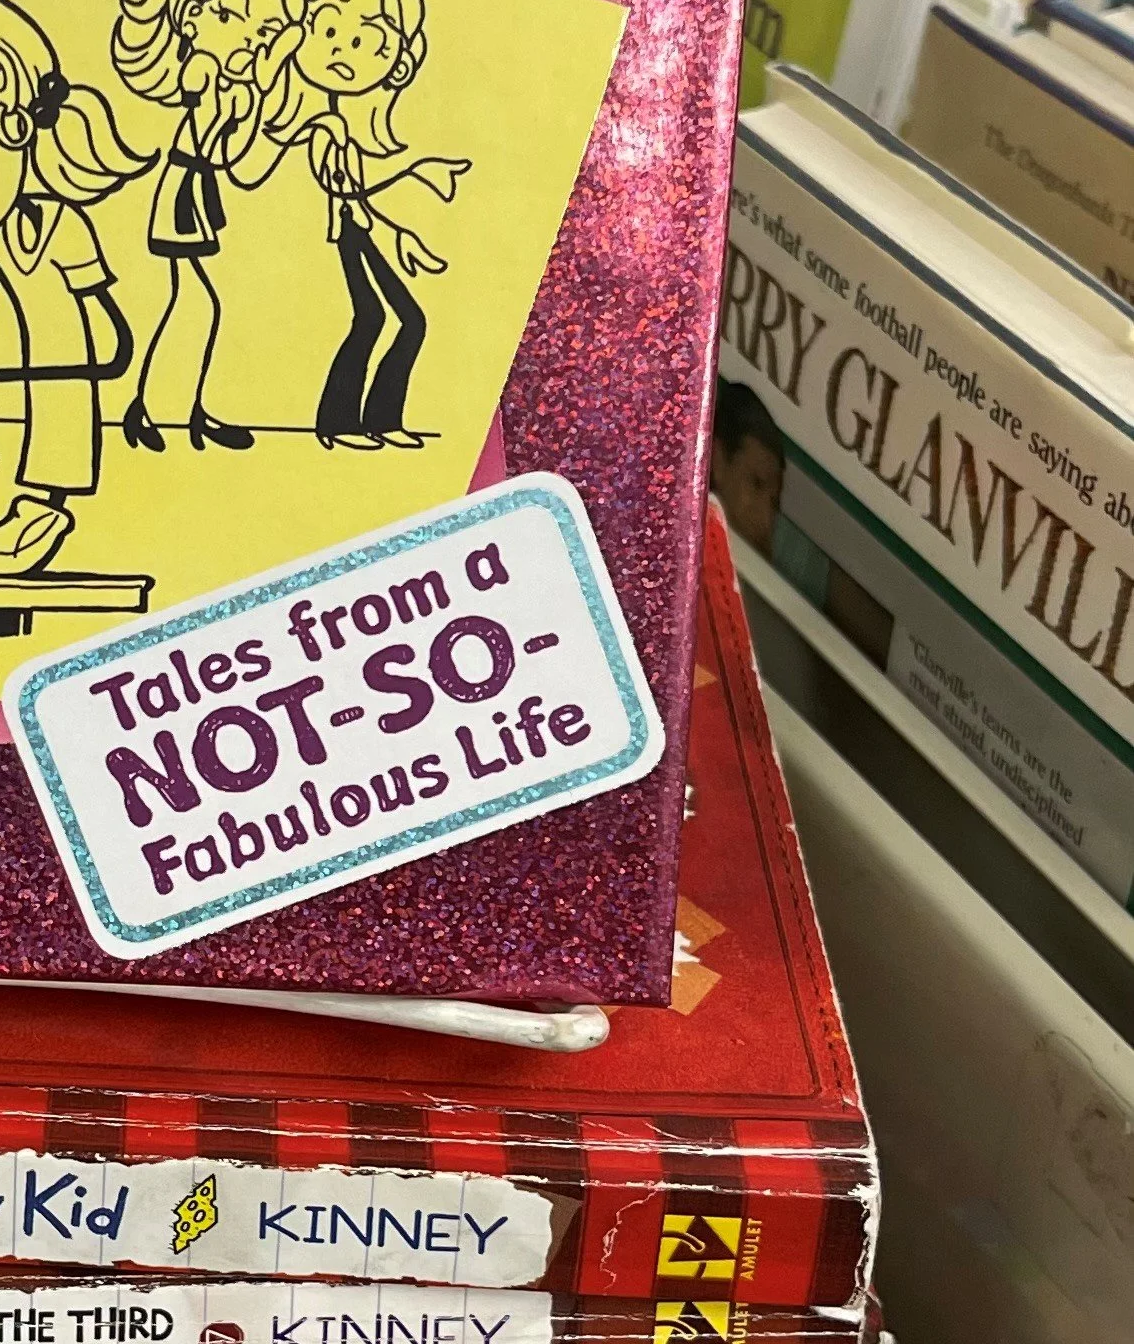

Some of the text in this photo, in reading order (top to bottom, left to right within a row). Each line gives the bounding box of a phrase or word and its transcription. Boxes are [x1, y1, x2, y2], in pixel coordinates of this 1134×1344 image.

[763, 212, 802, 262] what
[805, 249, 851, 301] some
[853, 282, 924, 360] football
[924, 345, 987, 411] people
[989, 397, 1023, 441] are
[1028, 429, 1099, 506] saying
[1103, 491, 1134, 537] ab
[90, 542, 510, 731] Tales from a
[105, 614, 559, 828] NOT-SO-
[141, 695, 592, 895] Fabulous Life
[990, 749, 1084, 848] undisciplined
[1022, 747, 1047, 780] are
[1048, 767, 1073, 805] the
[22, 1167, 130, 1242] Kid
[257, 1200, 509, 1256] KINNEY
[738, 1217, 762, 1281] AMULET
[66, 1306, 174, 1343] THIRD
